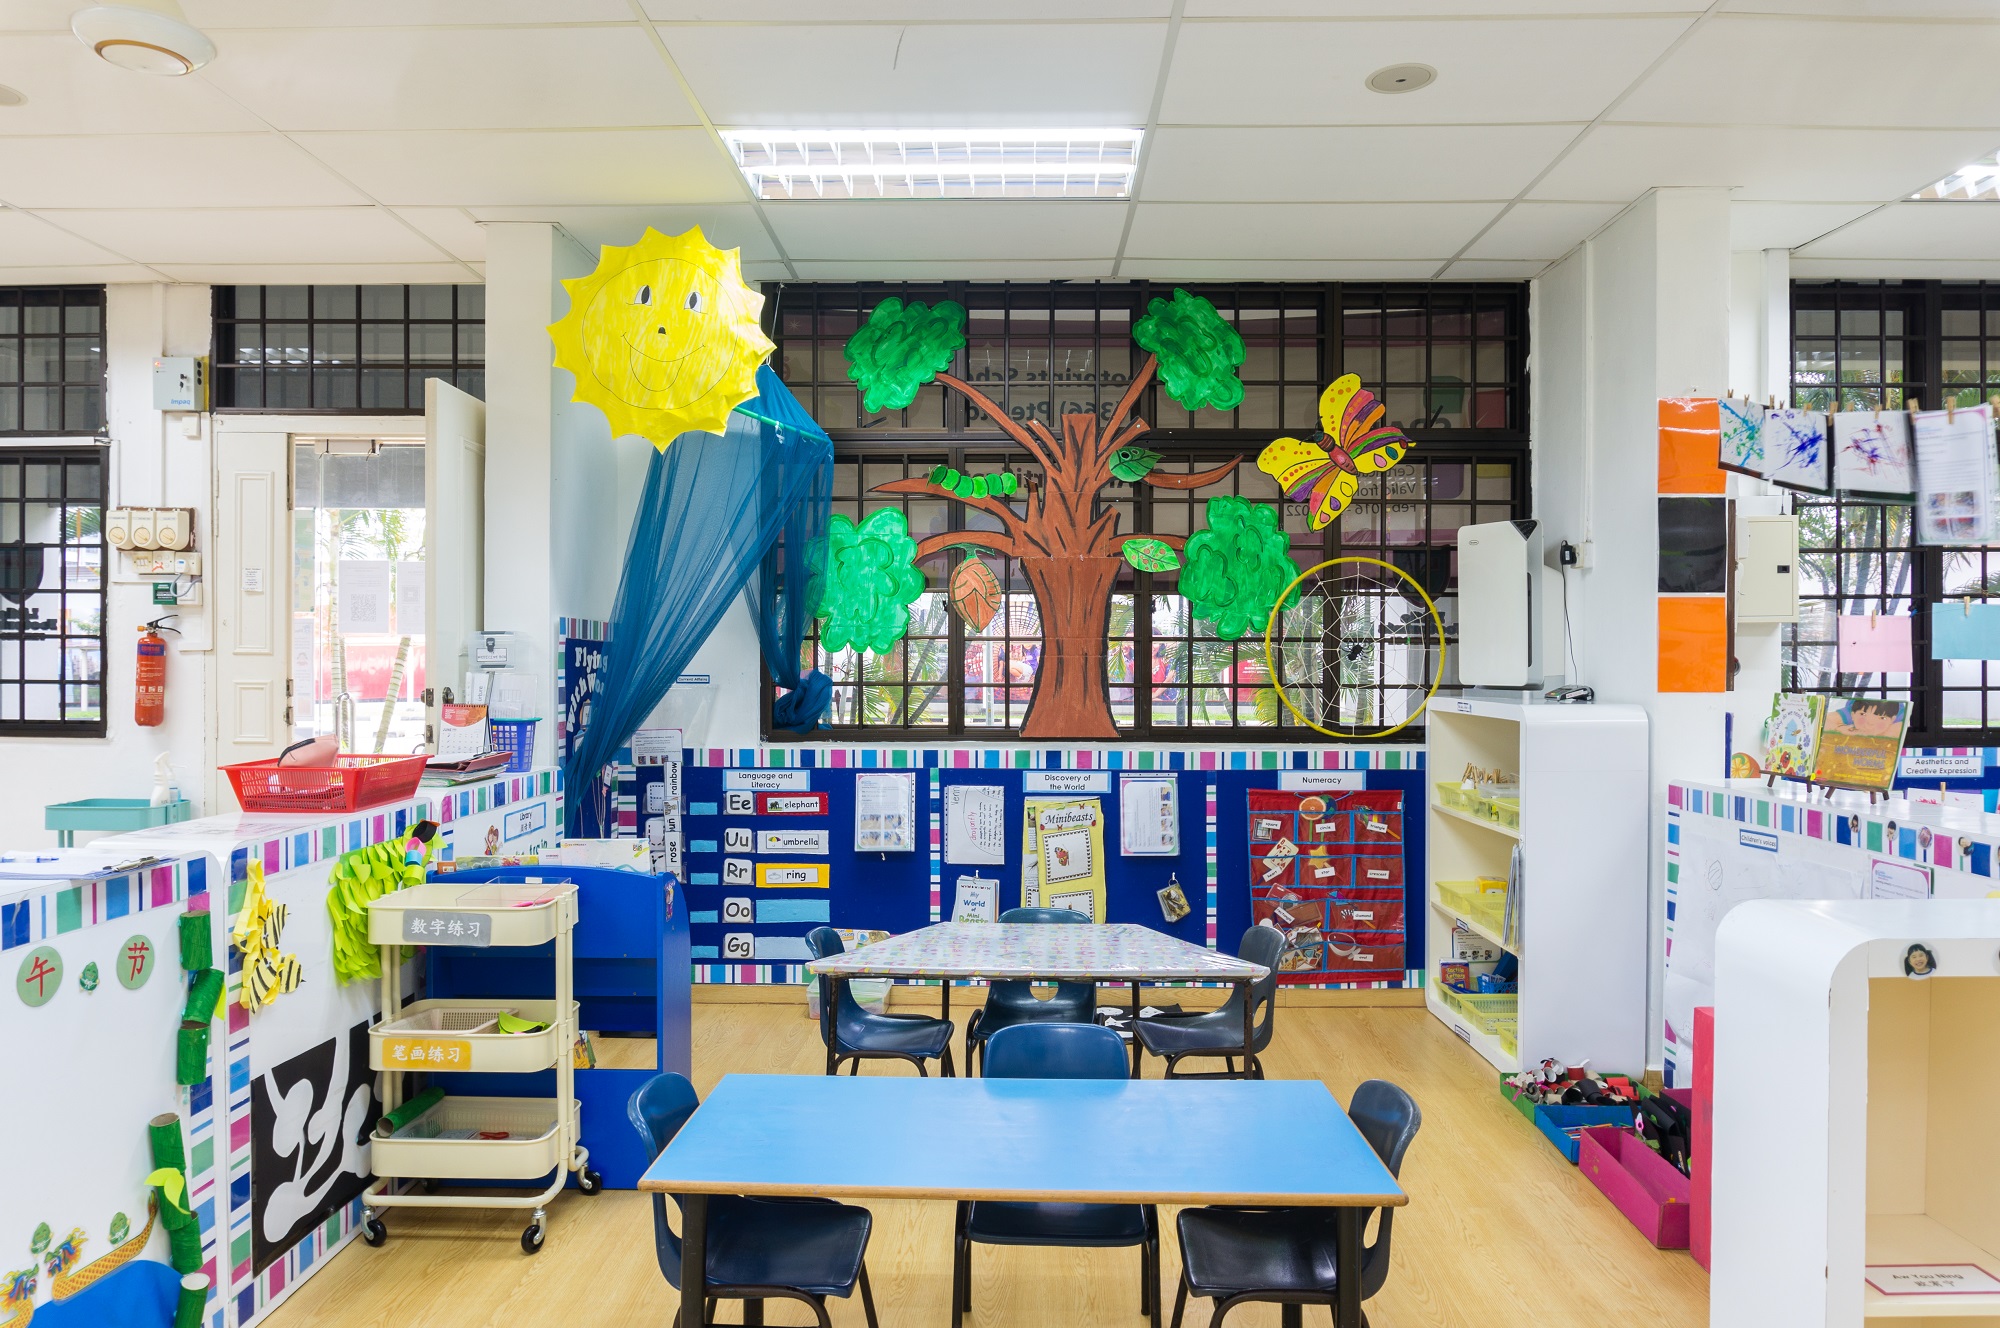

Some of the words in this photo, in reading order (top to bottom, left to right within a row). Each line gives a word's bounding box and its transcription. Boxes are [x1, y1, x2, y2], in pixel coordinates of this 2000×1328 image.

[1915, 758, 1952, 766] Aesthetics
[1954, 758, 1969, 766] and
[738, 772, 776, 780] Language
[778, 772, 793, 780] and
[1906, 767, 1937, 775] Creative
[1939, 767, 1978, 776] Expression
[670, 762, 678, 796] rainbow
[1044, 774, 1082, 783] Discovery
[1083, 774, 1091, 782] of
[1302, 777, 1342, 785] Numeracy
[751, 781, 780, 789] Literacy
[1050, 783, 1063, 791] the
[1063, 783, 1086, 791] World
[729, 794, 752, 810] Ee
[784, 800, 818, 810] elephant
[1045, 811, 1093, 825] Minibeasts
[725, 831, 749, 847] Uu
[783, 837, 819, 846] umbrella
[726, 862, 748, 879] Rr
[786, 870, 807, 881] ring
[963, 899, 986, 908] World
[410, 916, 481, 938] 数字练习
[727, 936, 751, 957] Gg
[25, 956, 56, 998] 午
[127, 941, 150, 982] 节
[391, 1044, 461, 1063] 笔画练习
